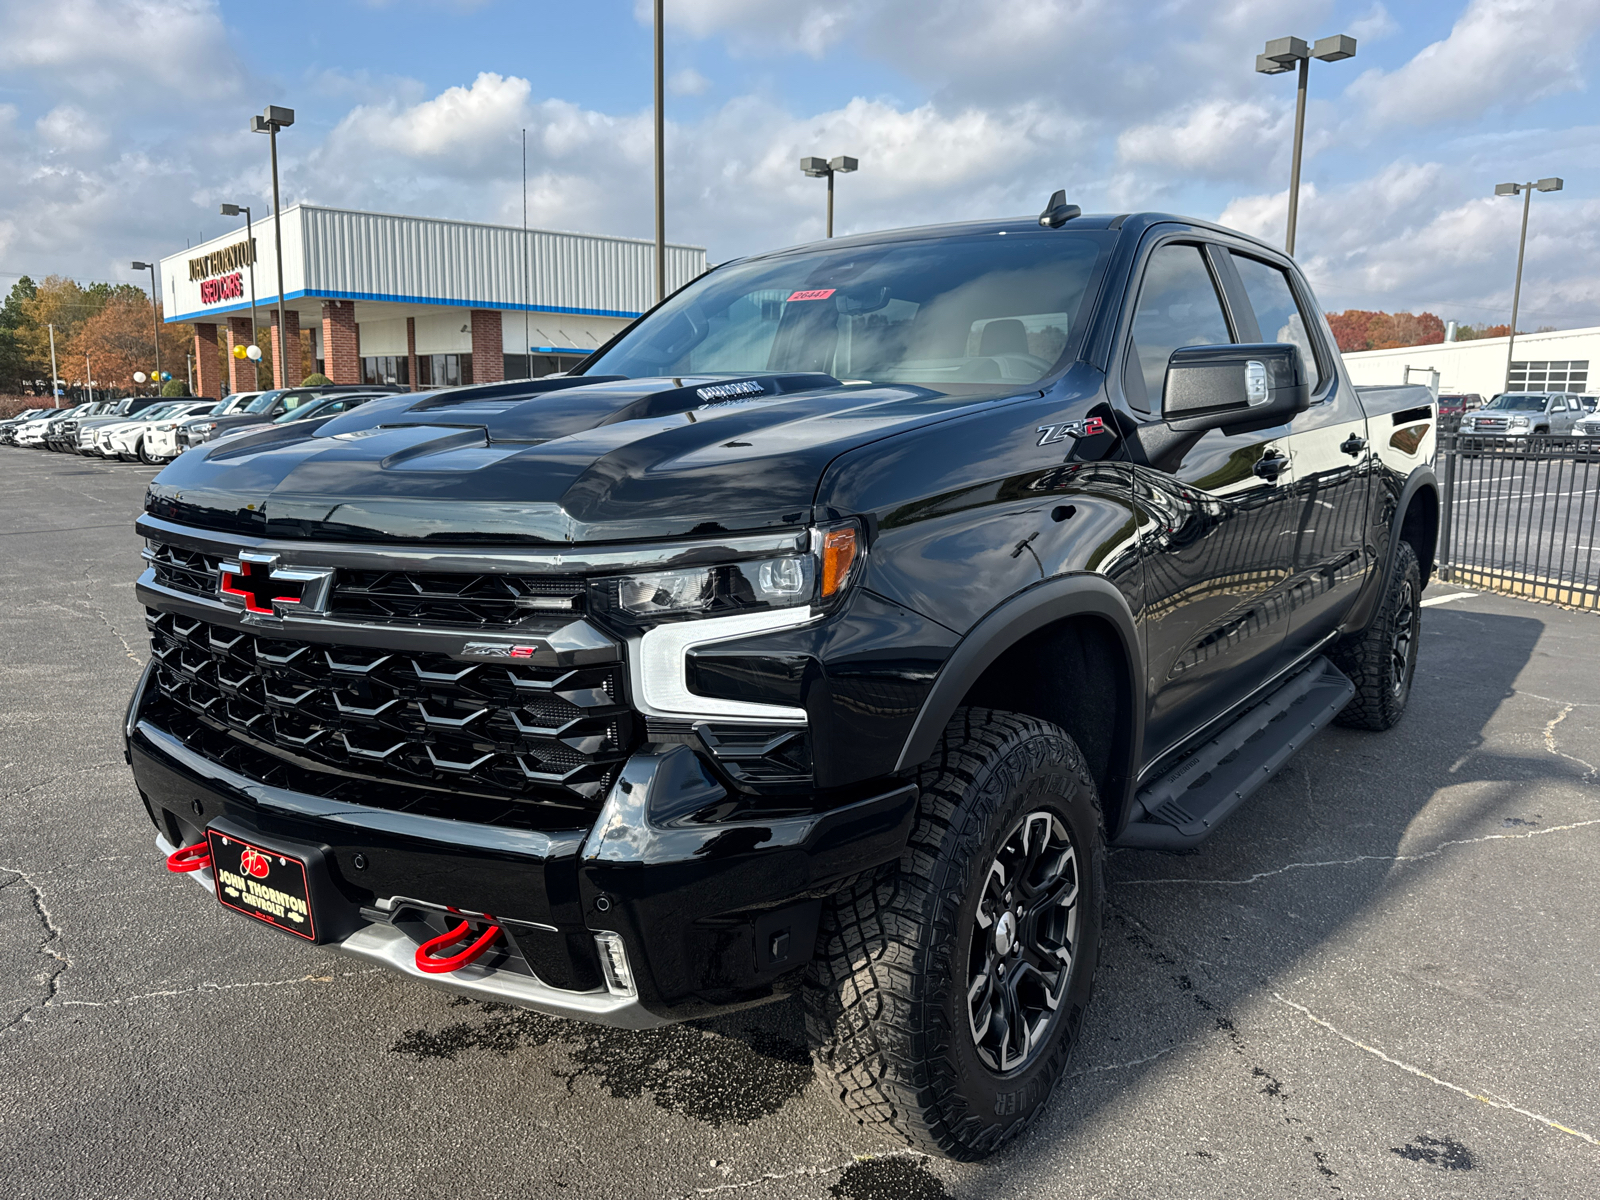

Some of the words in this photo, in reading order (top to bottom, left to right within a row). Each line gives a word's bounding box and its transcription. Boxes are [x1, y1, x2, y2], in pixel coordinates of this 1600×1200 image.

[188, 255, 209, 282] JOHN
[200, 279, 220, 304] USED
[219, 272, 242, 299] CARS
[793, 290, 829, 299] 26447
[1036, 417, 1104, 446] ZR2
[219, 869, 247, 891] JOHN
[247, 880, 307, 915] THORNTON
[242, 892, 285, 918] CHEVROLET
